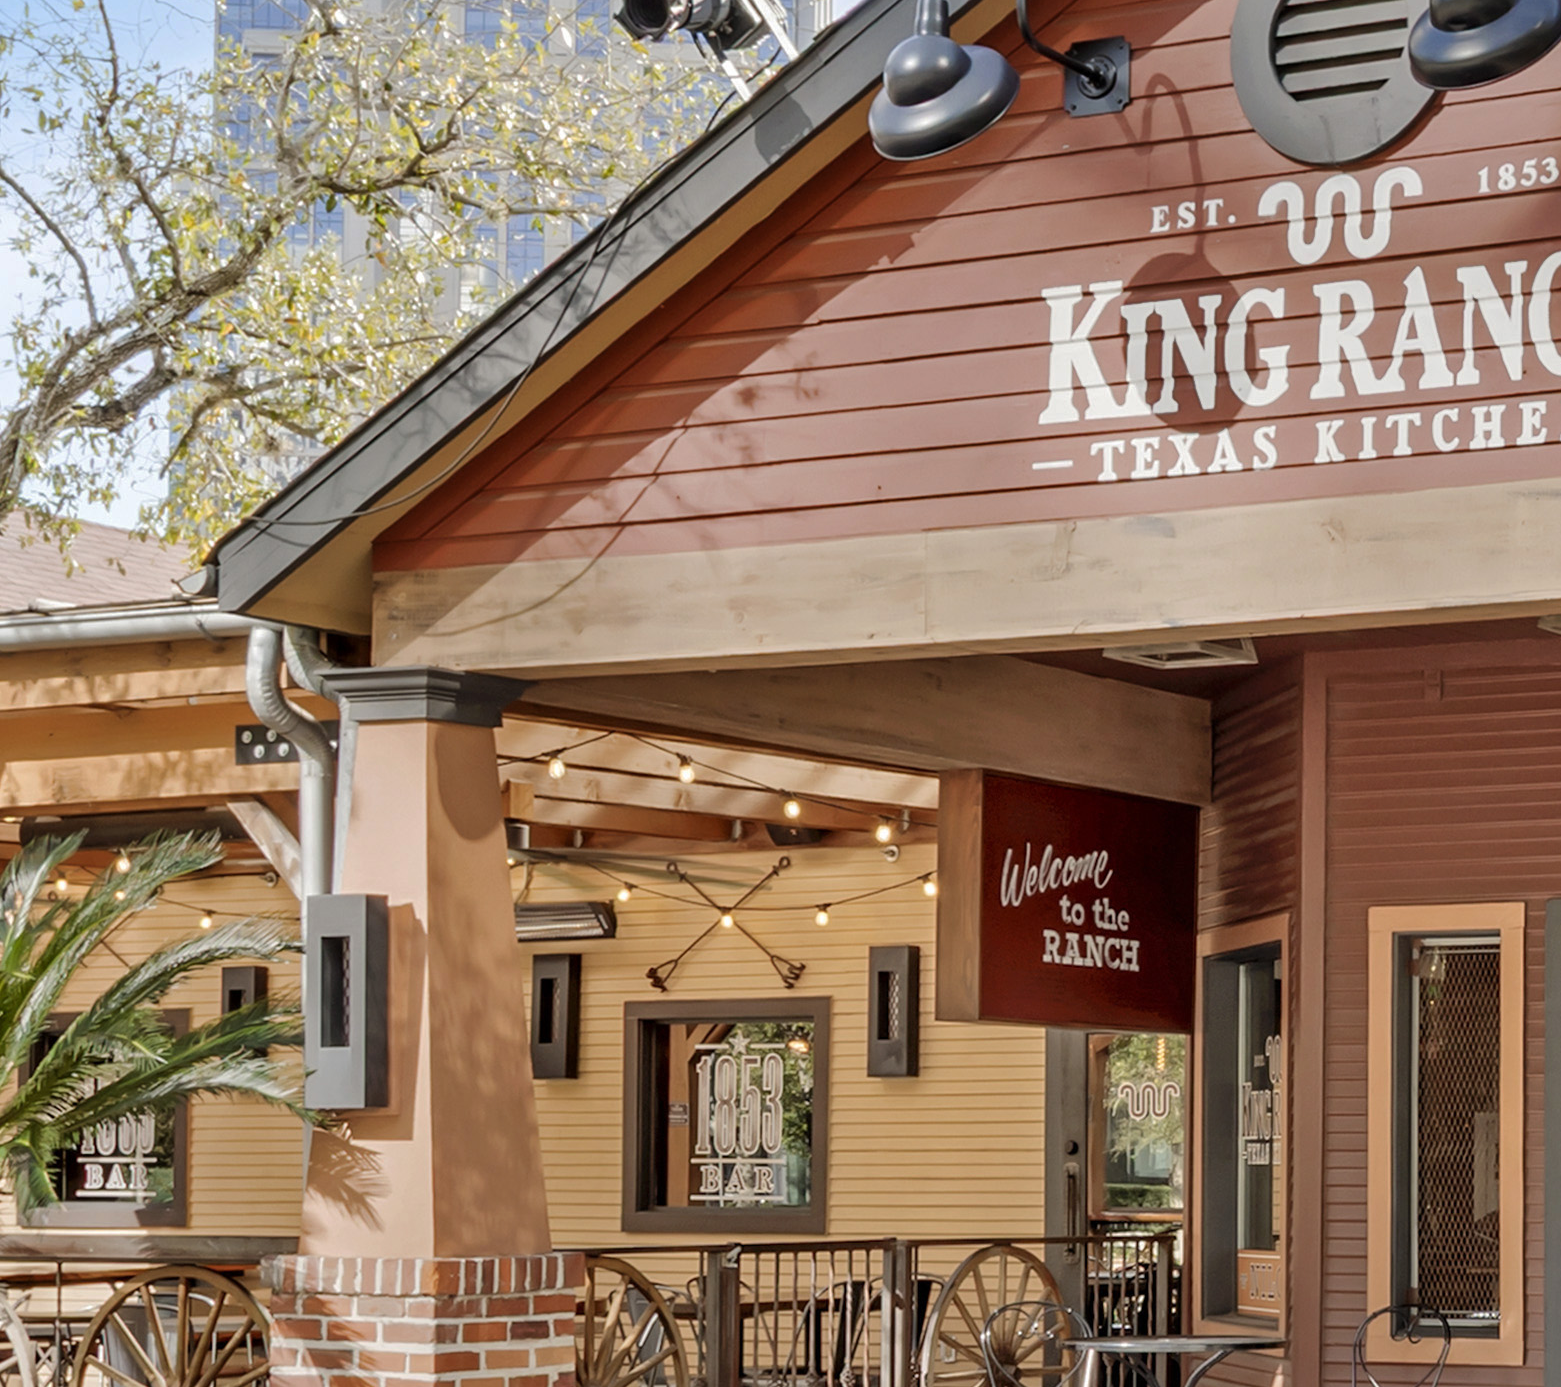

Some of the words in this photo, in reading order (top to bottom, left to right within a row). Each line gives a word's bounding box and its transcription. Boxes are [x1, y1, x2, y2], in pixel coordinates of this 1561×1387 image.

[1149, 199, 1237, 233] EST.
[1477, 156, 1560, 194] 1853
[1038, 280, 1290, 424] KING
[1090, 425, 1279, 482] TEXAS
[1000, 842, 1113, 907] Welcome
[1058, 894, 1085, 926] to
[1092, 897, 1130, 931] the
[1042, 929, 1140, 972] RANCH
[695, 1053, 784, 1155] 1853
[83, 1163, 150, 1190] BAR
[700, 1165, 775, 1194] BAR
